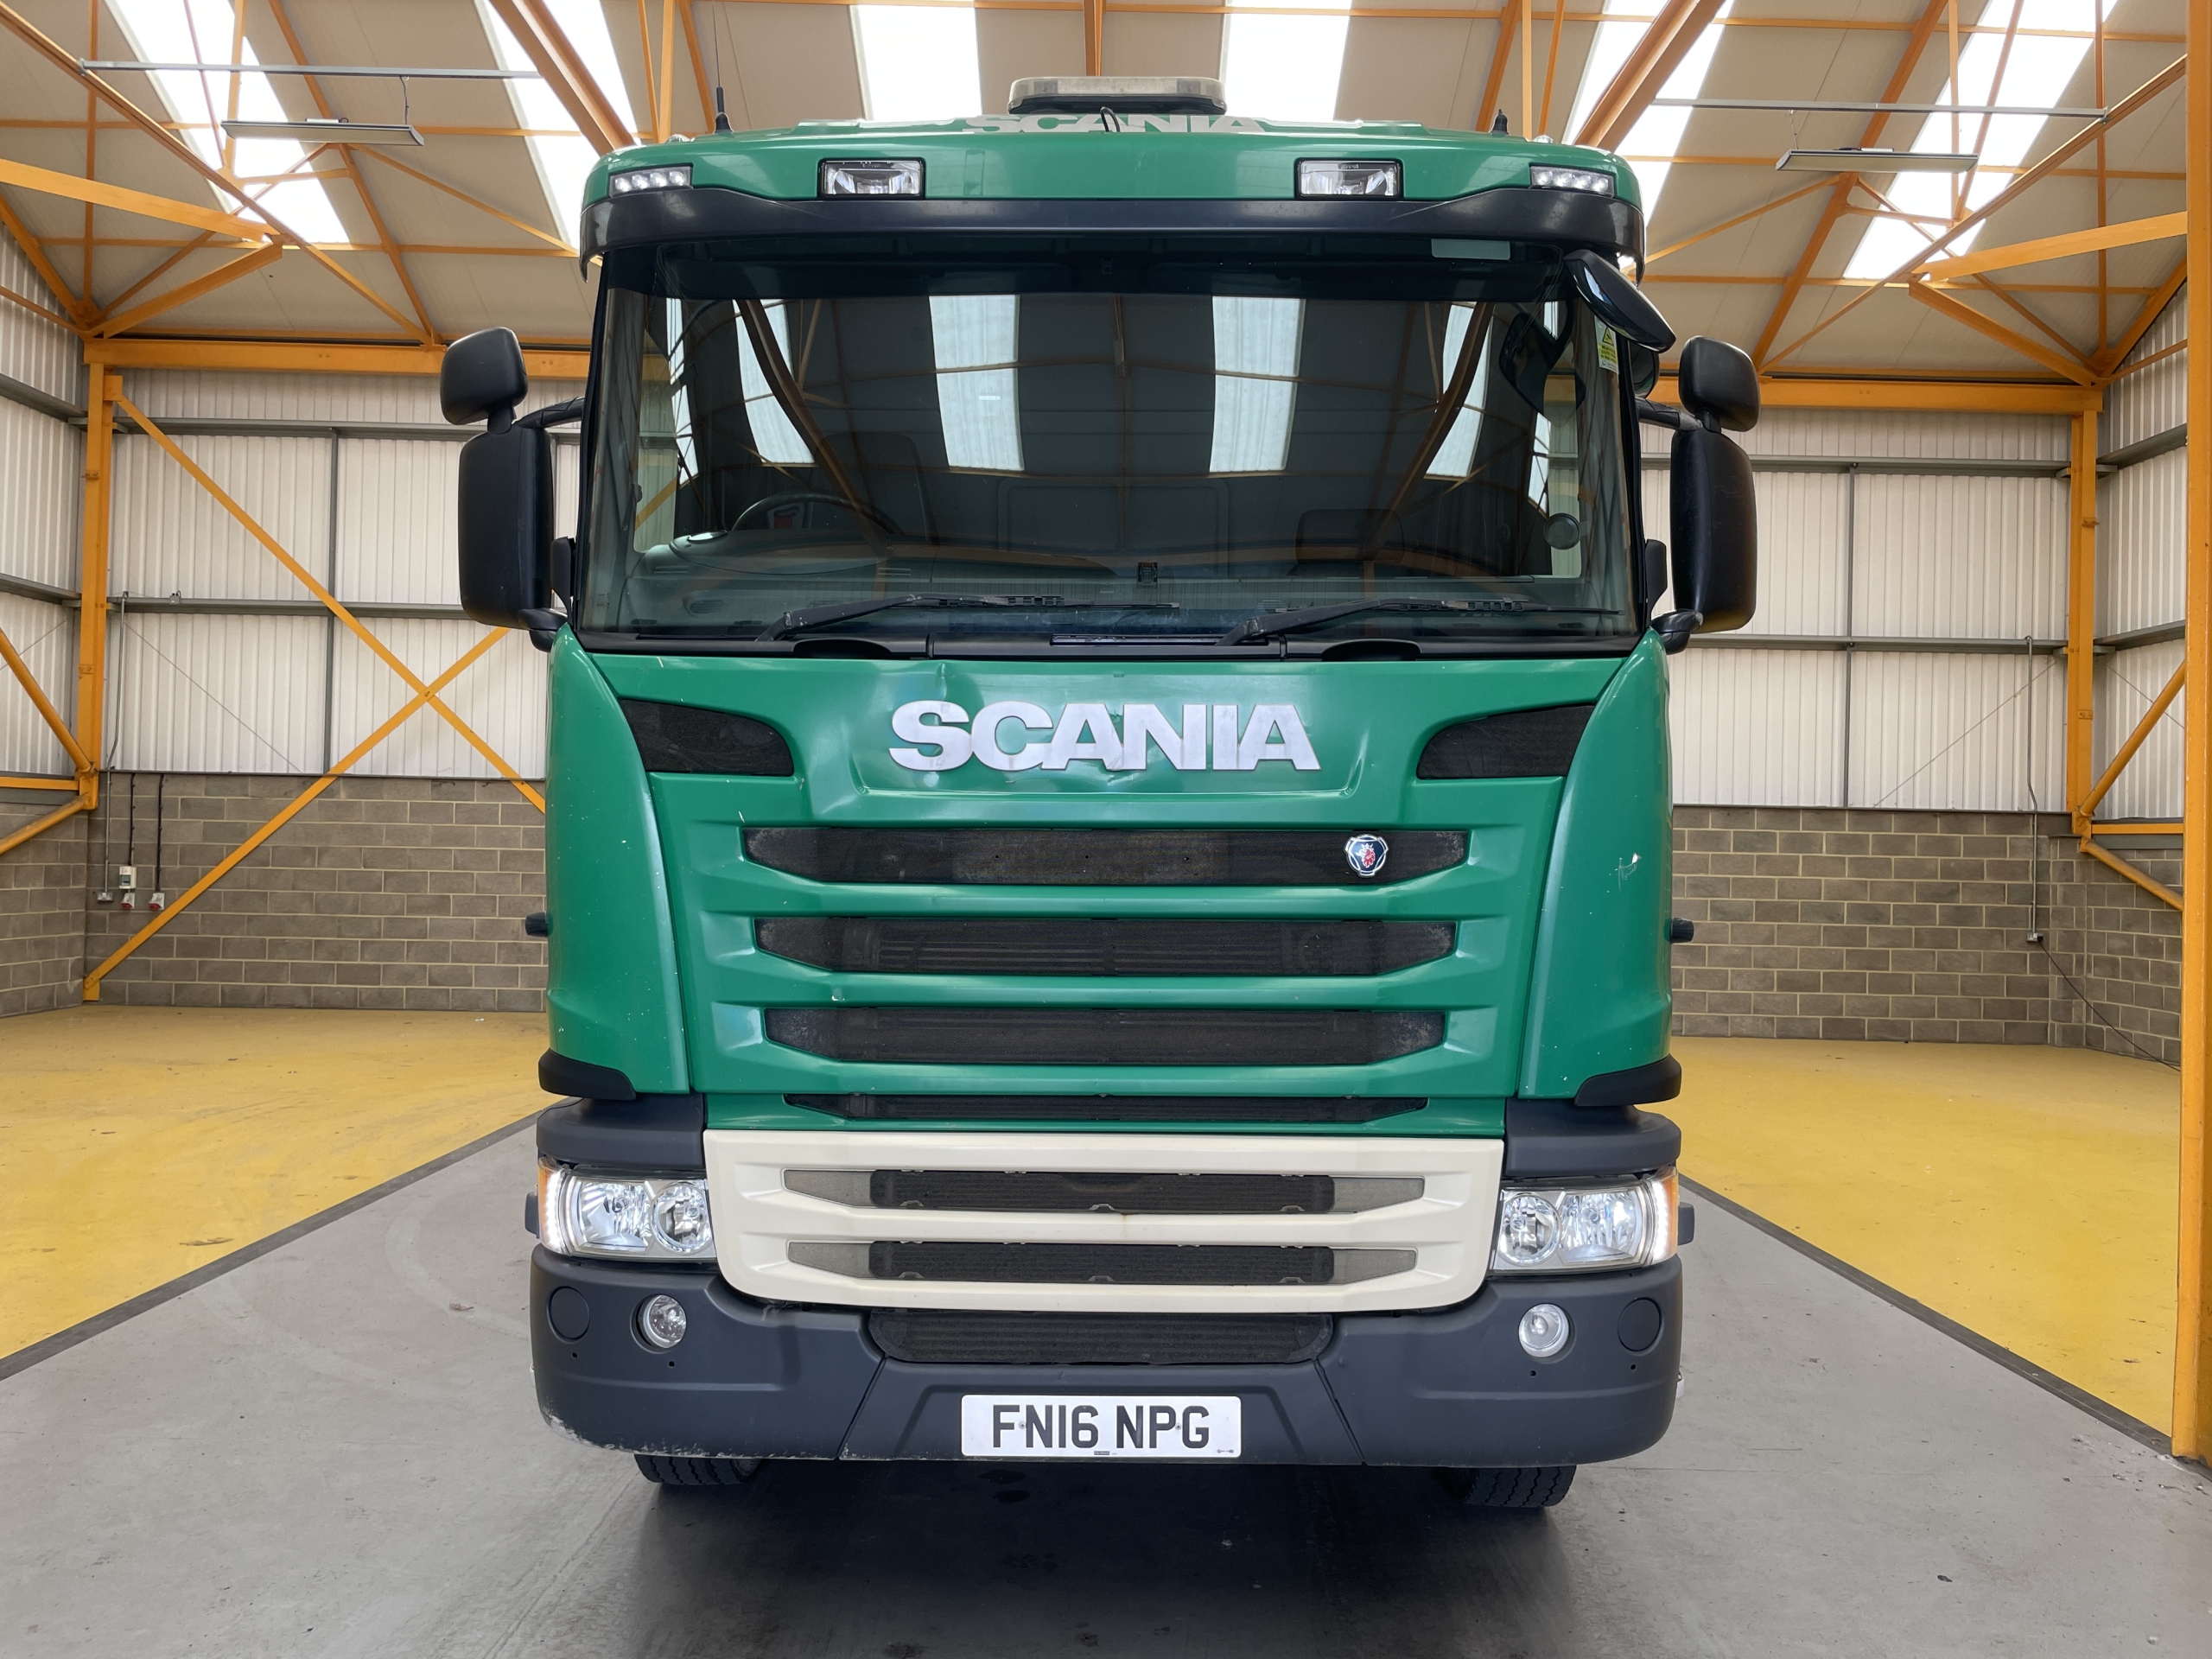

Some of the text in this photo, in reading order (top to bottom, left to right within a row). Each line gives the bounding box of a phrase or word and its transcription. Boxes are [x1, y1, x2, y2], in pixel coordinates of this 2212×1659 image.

[963, 114, 1266, 133] SCANIA
[888, 700, 1322, 771] SCANIA
[993, 1404, 1210, 1449] FN16 NPG
